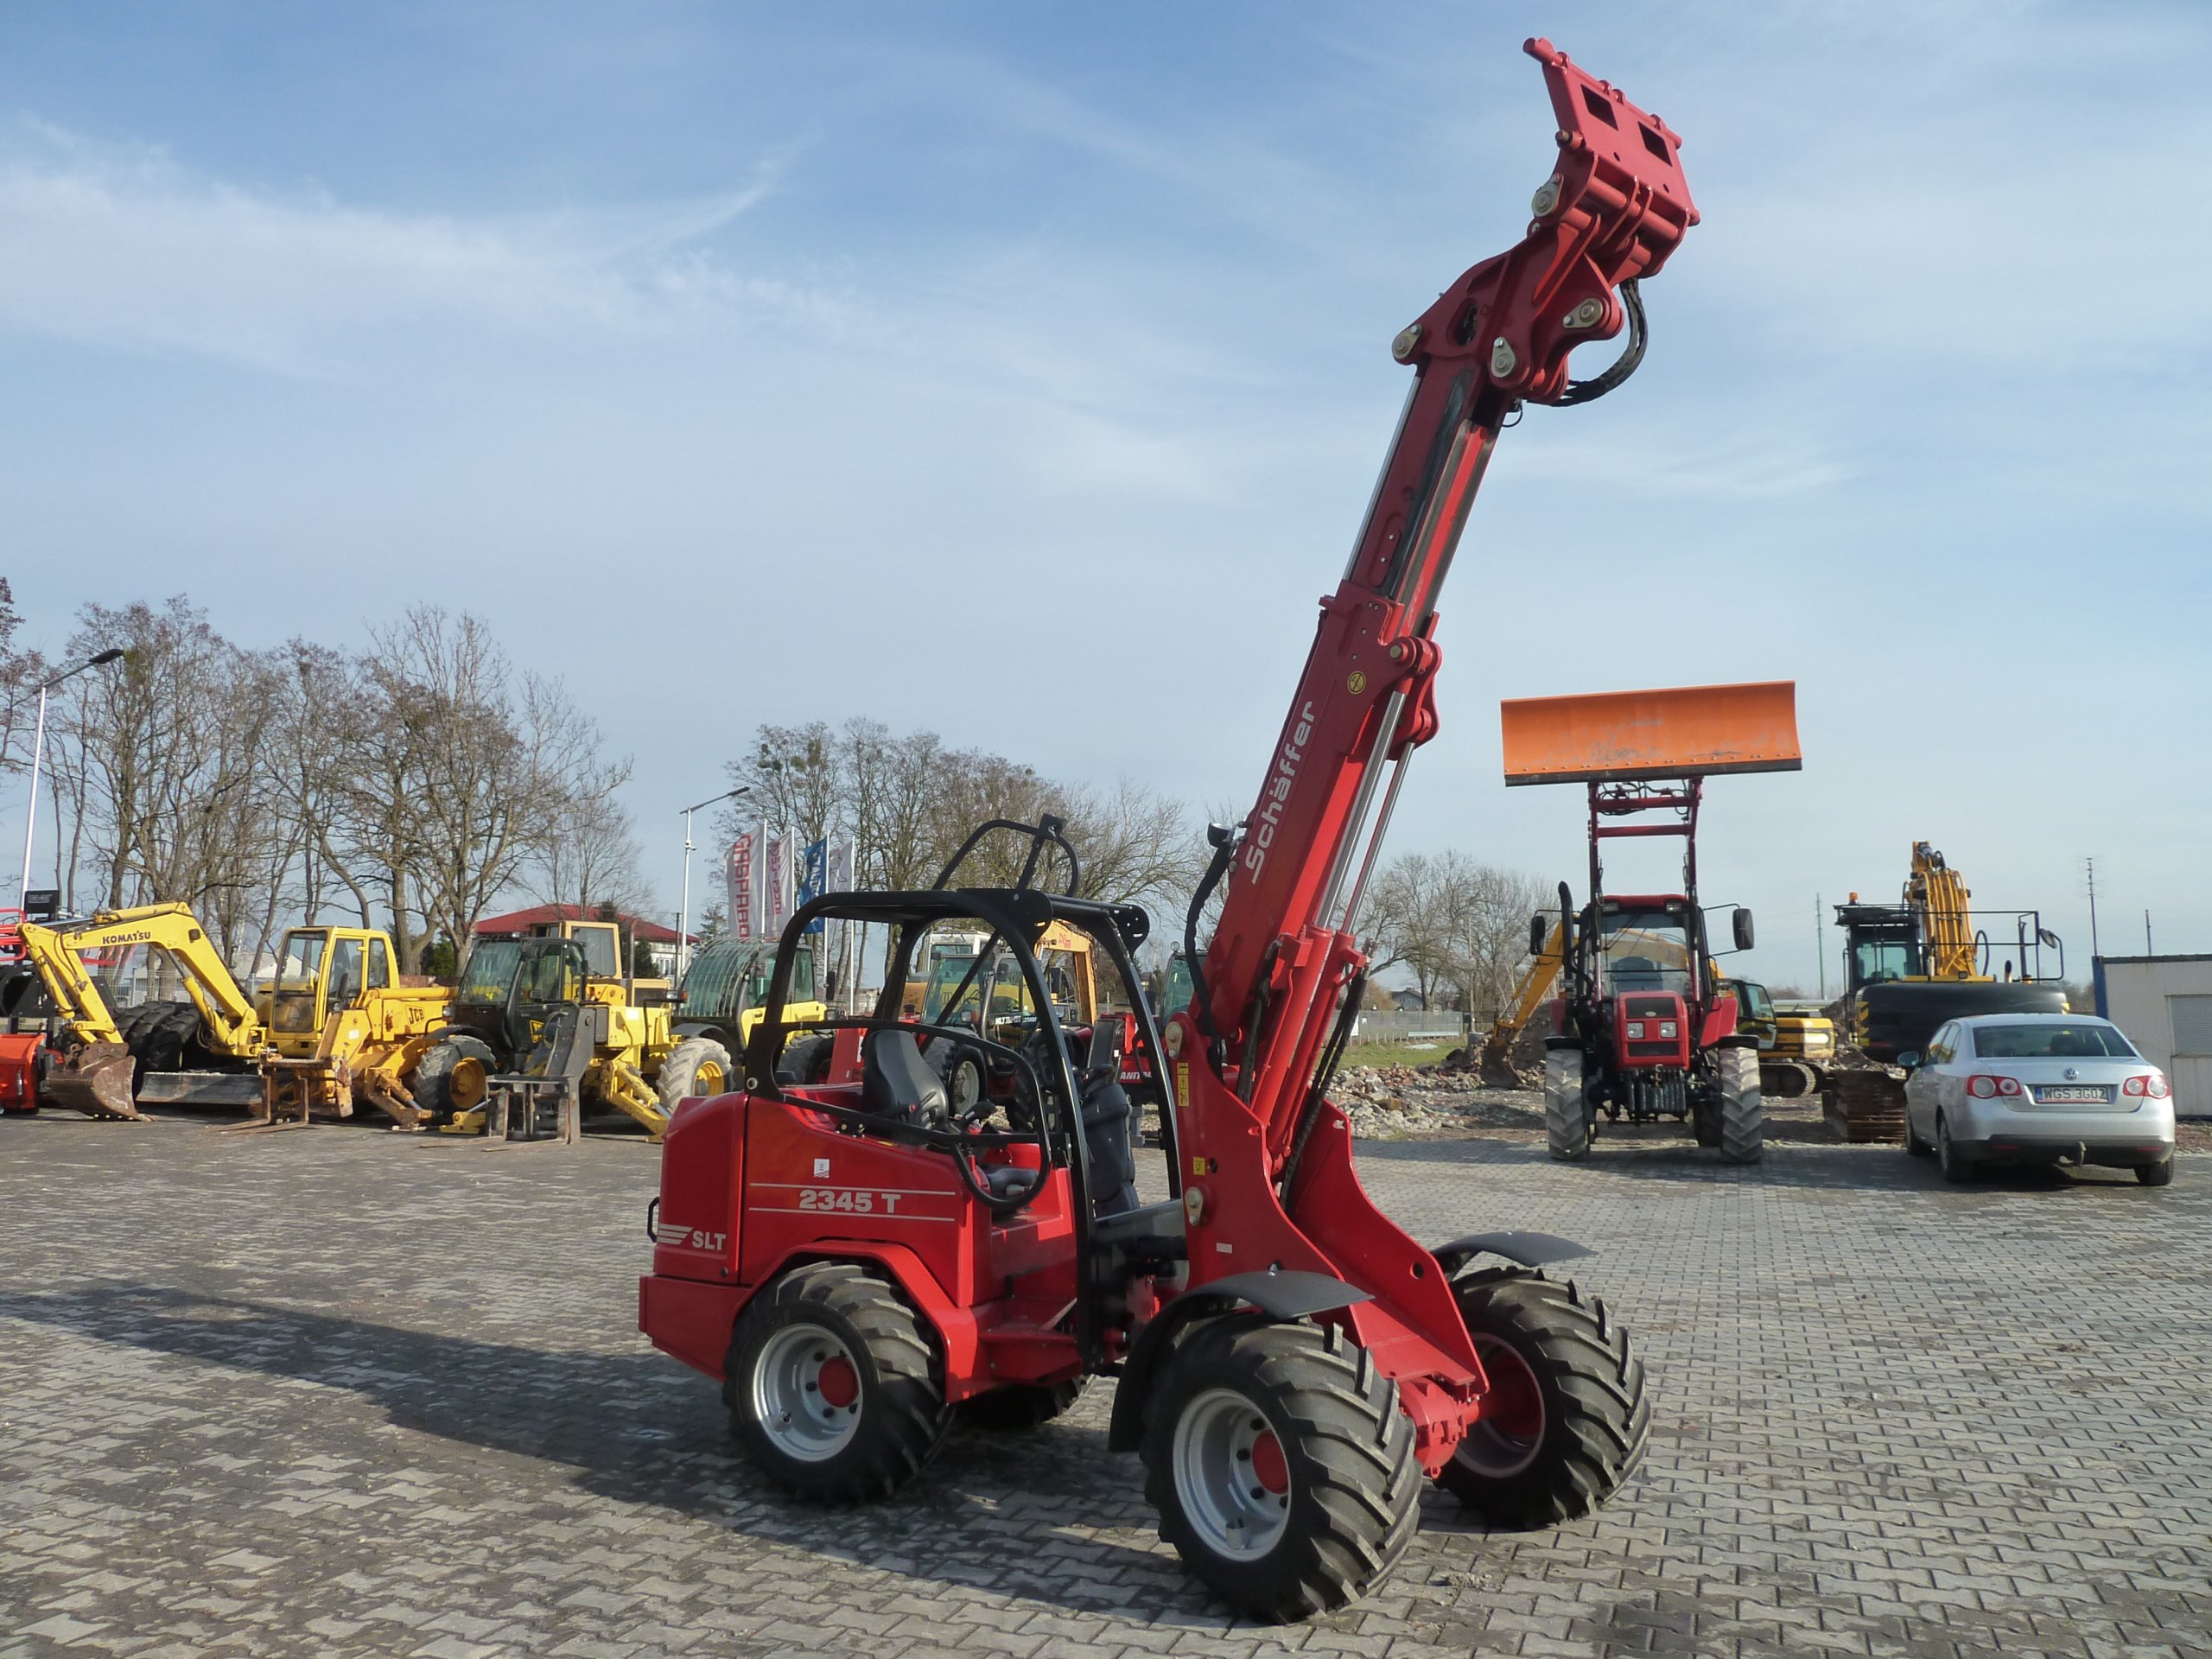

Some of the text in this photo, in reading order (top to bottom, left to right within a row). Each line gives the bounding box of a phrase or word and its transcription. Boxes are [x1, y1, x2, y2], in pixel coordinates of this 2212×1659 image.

[1244, 701, 1315, 885] Schäffer
[733, 834, 752, 938] GASPARD
[102, 930, 151, 945] KOMATSU
[409, 1007, 424, 1025] JCB
[2044, 1089, 2106, 1099] WGS 3G02
[799, 1189, 901, 1213] 2345 T
[692, 1230, 727, 1251] SLT
